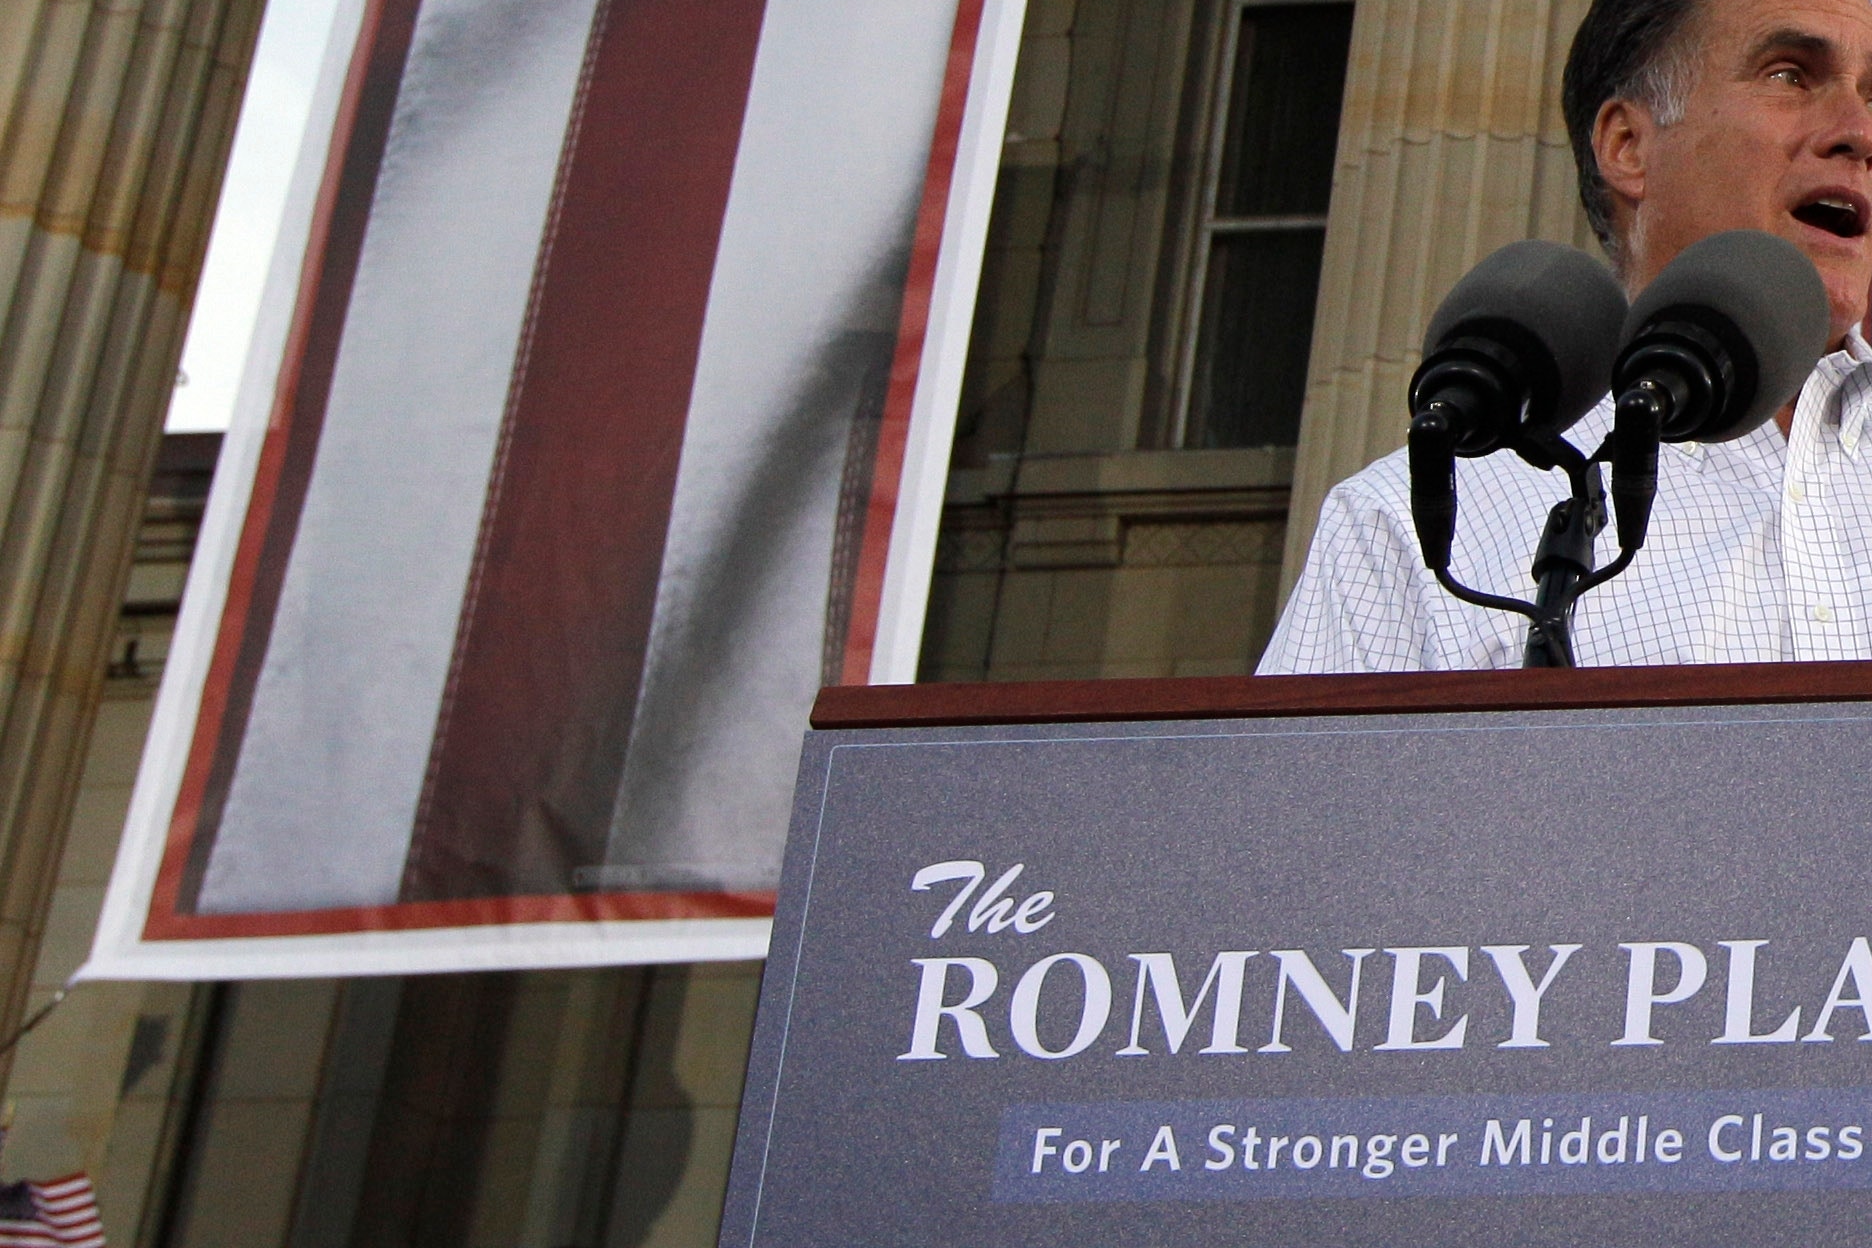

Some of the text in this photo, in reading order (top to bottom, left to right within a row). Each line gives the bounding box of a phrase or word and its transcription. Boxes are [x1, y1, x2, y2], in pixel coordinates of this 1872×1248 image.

[910, 859, 1057, 940] The
[895, 942, 1585, 1061] ROMNEY
[1030, 1113, 1864, 1180] For A Stronger Middle Class
